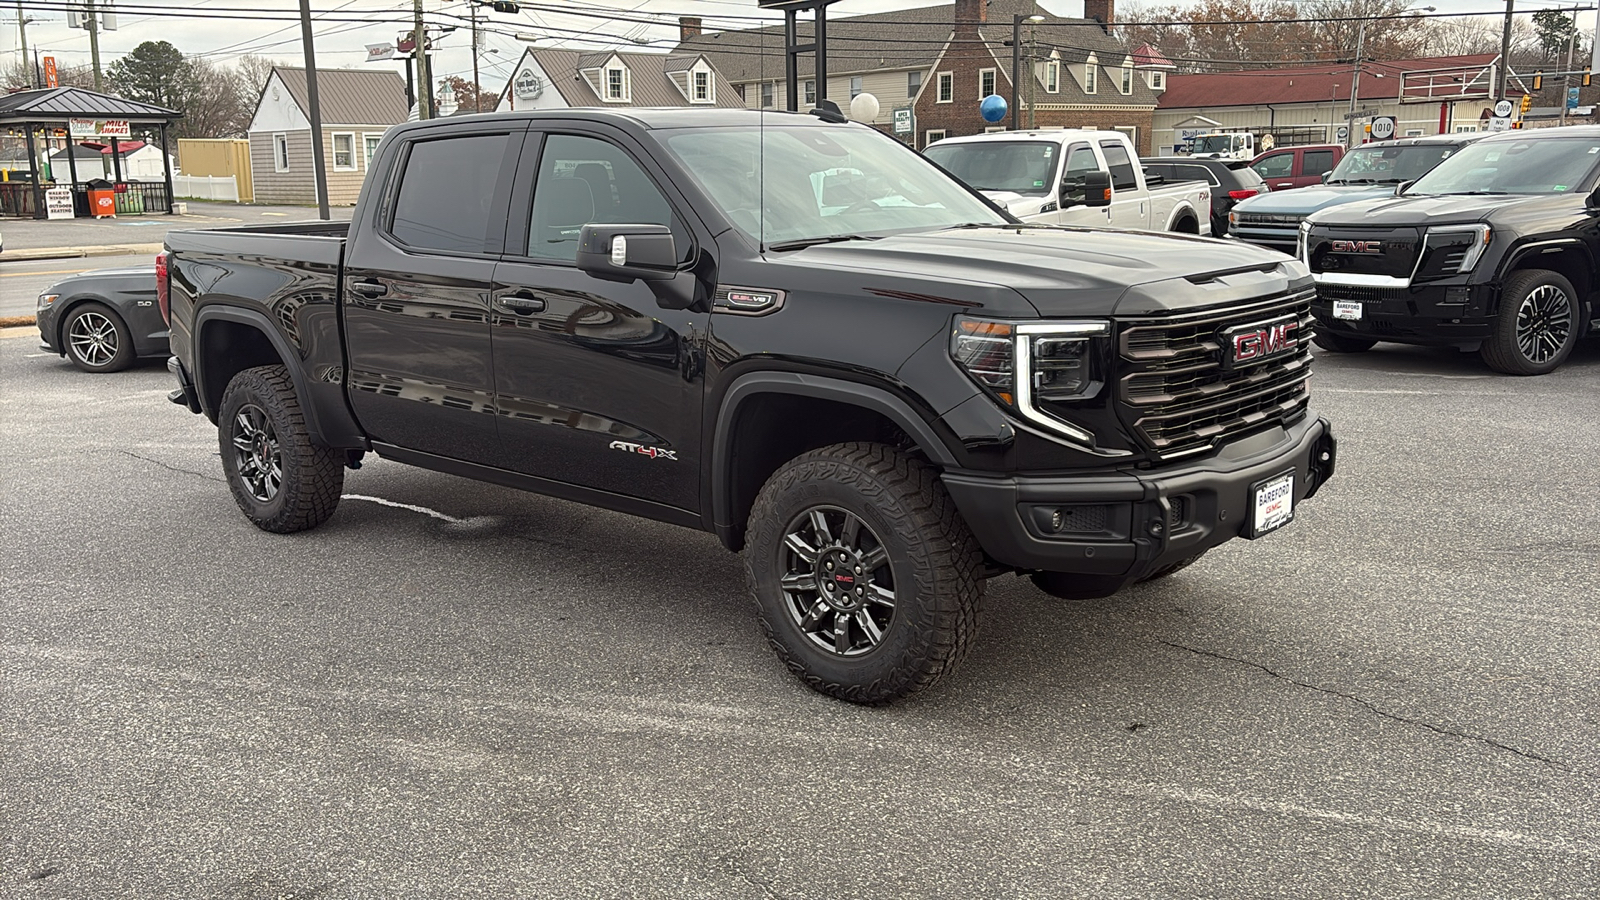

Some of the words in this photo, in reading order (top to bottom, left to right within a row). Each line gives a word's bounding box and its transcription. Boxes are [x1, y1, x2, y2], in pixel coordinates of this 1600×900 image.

[1497, 104, 1510, 112] 1008
[101, 127, 129, 135] SHAKES
[1374, 123, 1392, 132] 1010
[1332, 240, 1381, 253] GMC
[1336, 303, 1360, 311] BAREFORD
[1233, 321, 1298, 363] GMC
[609, 440, 678, 461] AT4X
[1259, 483, 1290, 507] BAREFORD
[1265, 500, 1282, 514] GMC
[835, 574, 854, 583] GMC
